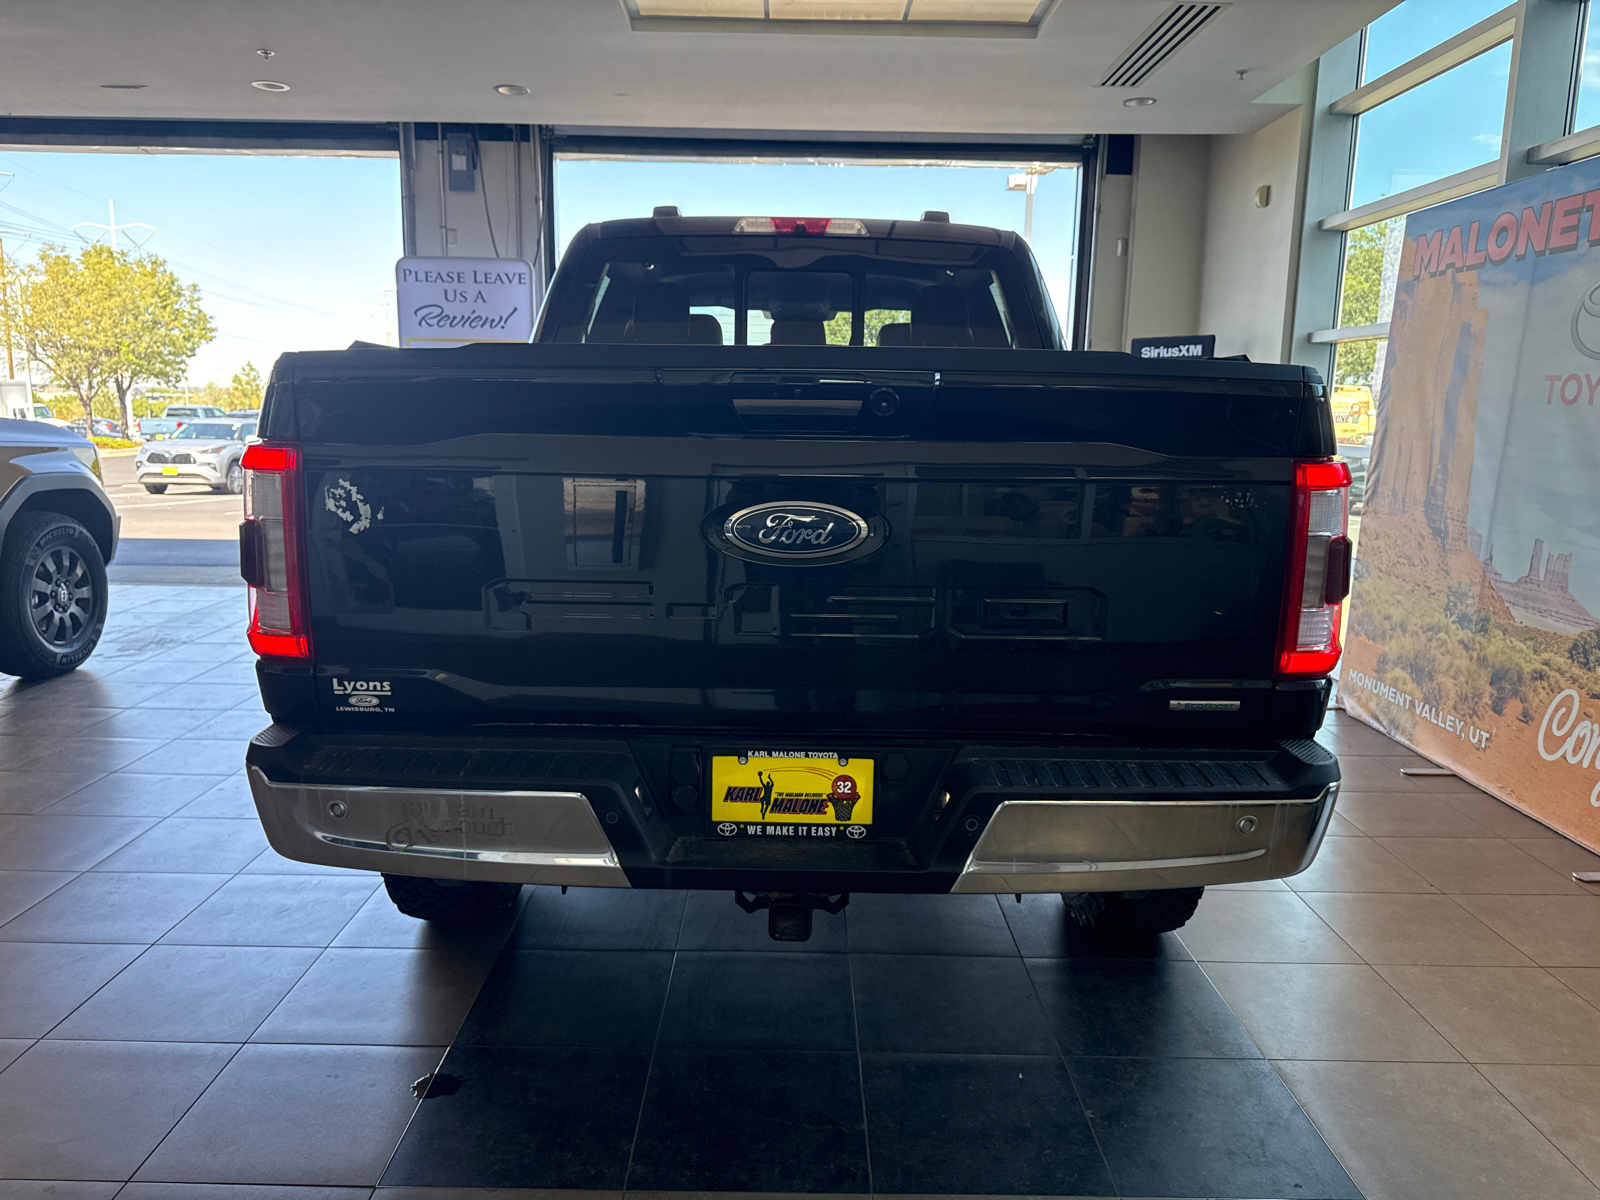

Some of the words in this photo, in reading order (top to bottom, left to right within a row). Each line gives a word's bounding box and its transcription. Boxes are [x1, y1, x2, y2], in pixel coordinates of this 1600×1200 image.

[402, 268, 466, 284] PLEASE
[472, 270, 527, 285] LEAVE
[443, 288, 468, 303] US
[473, 290, 488, 303] A
[413, 304, 518, 329] Review!
[1140, 344, 1203, 358] SiriusXM
[1544, 373, 1600, 406] TOY
[758, 512, 834, 545] Ford
[332, 678, 391, 694] Lyons
[1348, 668, 1412, 710] MONUMENT
[1414, 699, 1466, 741] VALLEY,
[1469, 724, 1490, 749] UT
[747, 750, 770, 758] KARL
[807, 751, 839, 759] TOYOTA
[723, 786, 763, 803] KARL
[836, 781, 852, 794] 32
[769, 798, 829, 815] MALONE
[747, 825, 763, 835] WE
[766, 825, 795, 836] MAKE
[798, 826, 808, 836] IT
[811, 826, 837, 837] EASY
